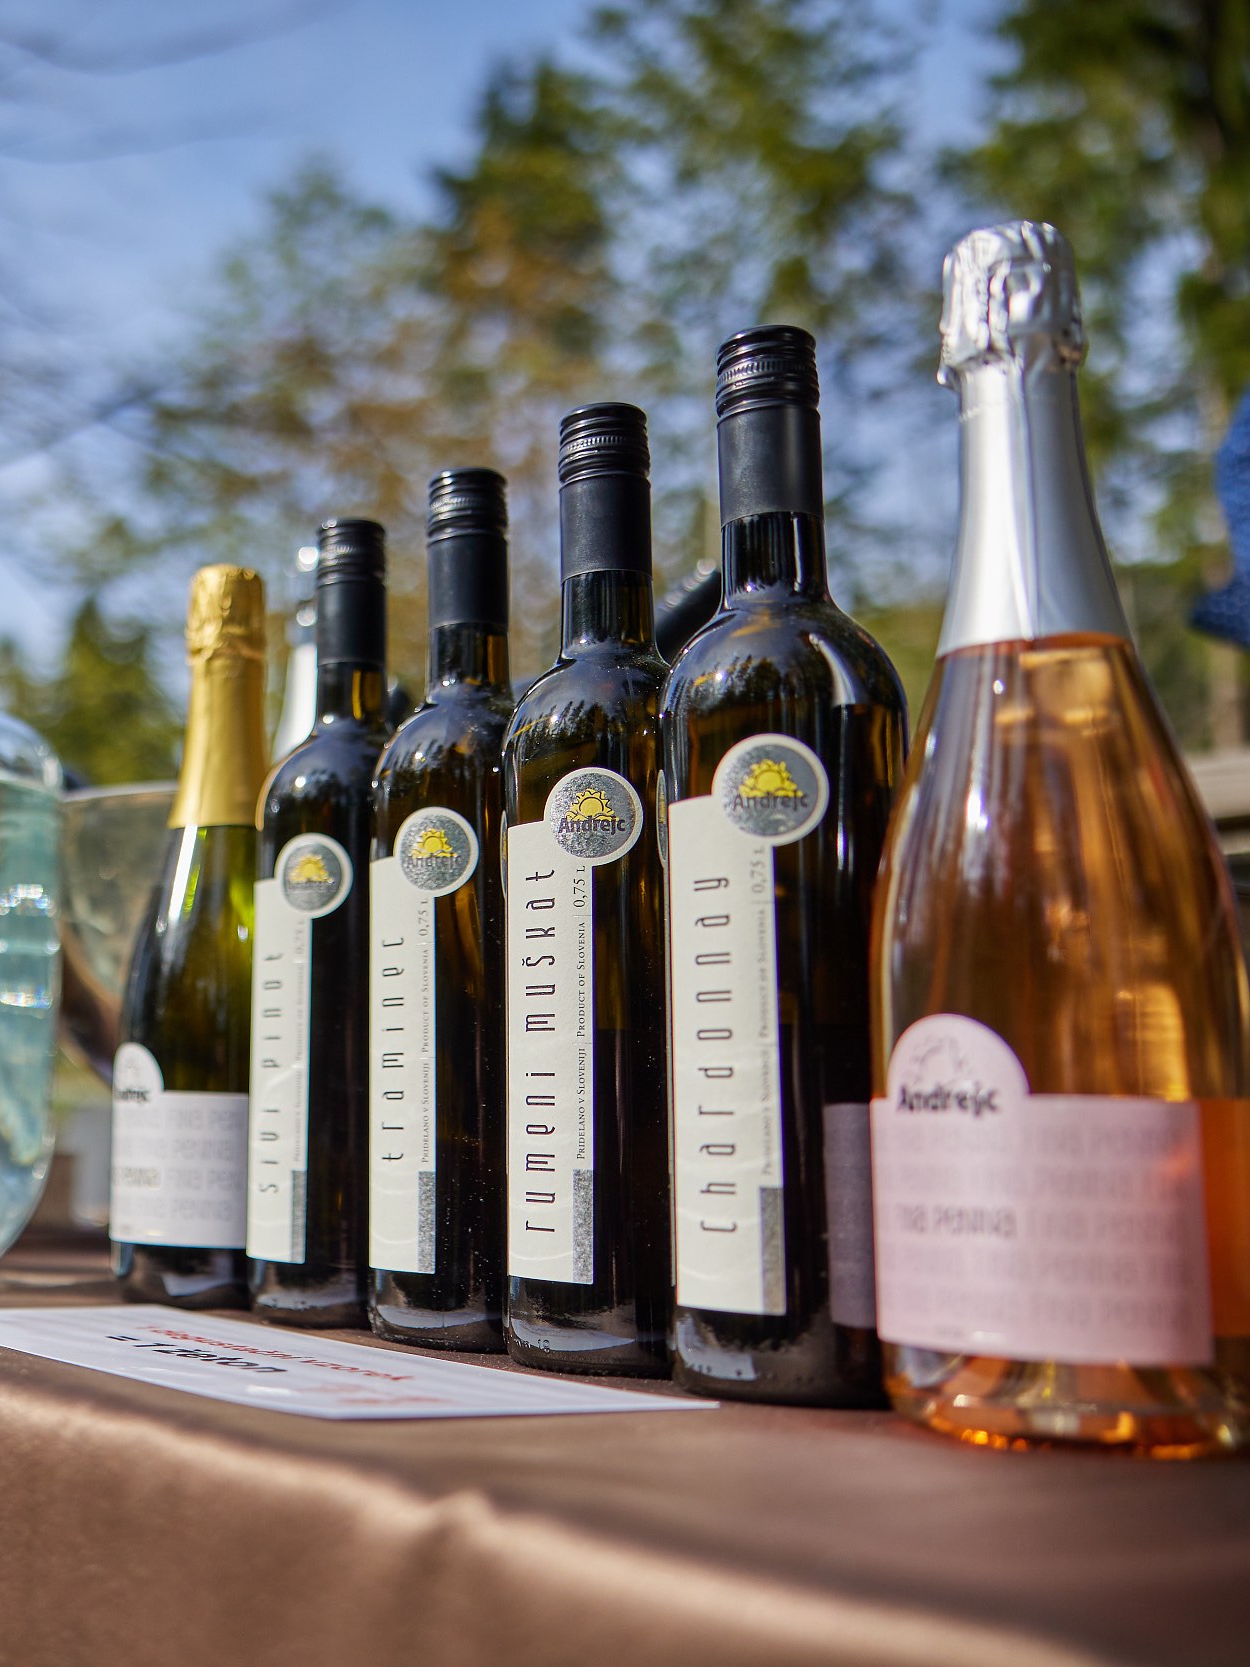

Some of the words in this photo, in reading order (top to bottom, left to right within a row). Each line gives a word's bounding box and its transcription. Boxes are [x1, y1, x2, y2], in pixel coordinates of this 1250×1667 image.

[732, 792, 809, 813] Andrejc
[558, 815, 625, 835] Andrejc
[750, 860, 767, 894] 0,75
[572, 878, 589, 909] 0,75
[417, 908, 431, 937] 0,75
[521, 868, 556, 1033] muškat
[380, 935, 405, 1163] traminec
[693, 876, 738, 1234] chardonnay
[896, 1085, 1000, 1117] Andrejc
[524, 1071, 556, 1233] rumeni
[152, 1347, 288, 1374] žeton
